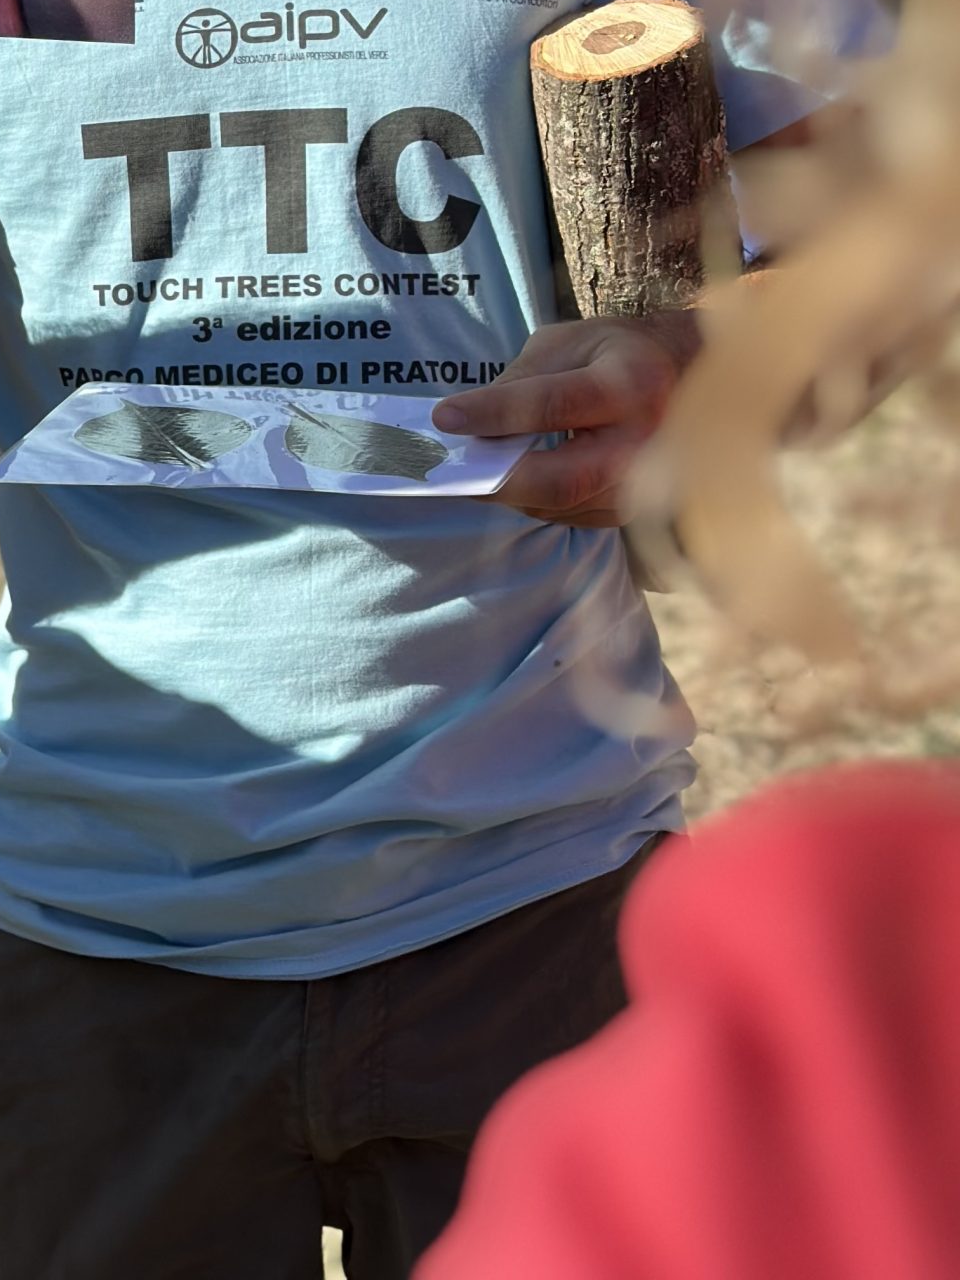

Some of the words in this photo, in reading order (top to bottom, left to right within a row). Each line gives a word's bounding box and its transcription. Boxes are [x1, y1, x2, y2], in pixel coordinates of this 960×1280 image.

[240, 2, 388, 49] aipv
[81, 106, 485, 262] TTC
[93, 277, 204, 307] TOUCH
[215, 274, 323, 299] TREES
[334, 273, 481, 298] CONTEST
[237, 316, 392, 343] edizione
[155, 362, 304, 386] MEDICEO
[316, 361, 348, 385] DI
[361, 360, 506, 385] PRATOLIN
